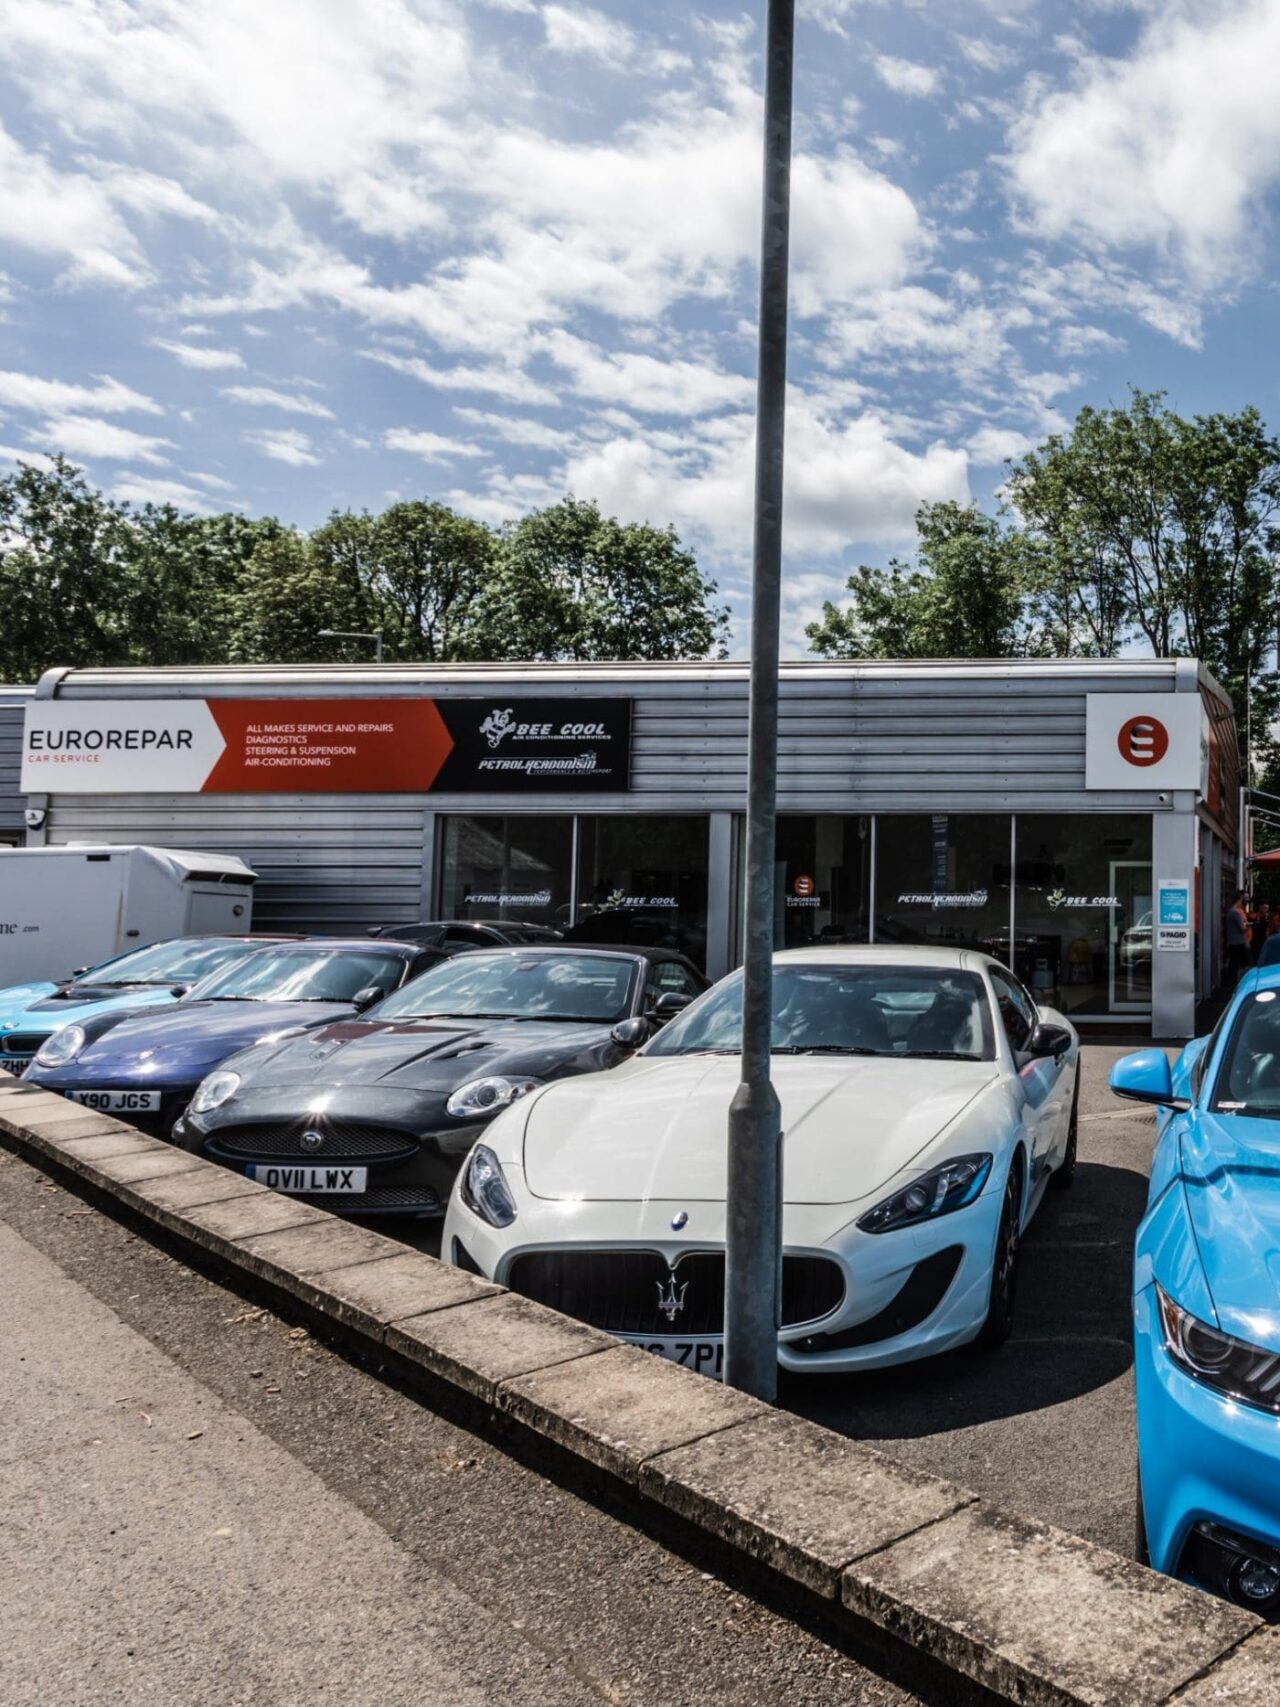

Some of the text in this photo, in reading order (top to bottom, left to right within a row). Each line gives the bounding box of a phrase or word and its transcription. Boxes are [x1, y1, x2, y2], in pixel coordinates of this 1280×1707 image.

[246, 723, 394, 733] ALL MAKES SERVICE AND REPAIRS
[516, 723, 605, 735] BEE COOL
[29, 729, 194, 750] EUROREPAR
[245, 735, 308, 744] DIAGNOSTICS
[245, 746, 357, 755] STEERING & SUSPENSION
[28, 754, 101, 763] CAR SERVICE
[244, 757, 331, 766] AIR-CONDITIONING
[1092, 896, 1118, 904] COOL
[1166, 931, 1187, 939] PAGID
[80, 1093, 152, 1109] X90 JGS
[310, 1169, 353, 1190] LWX
